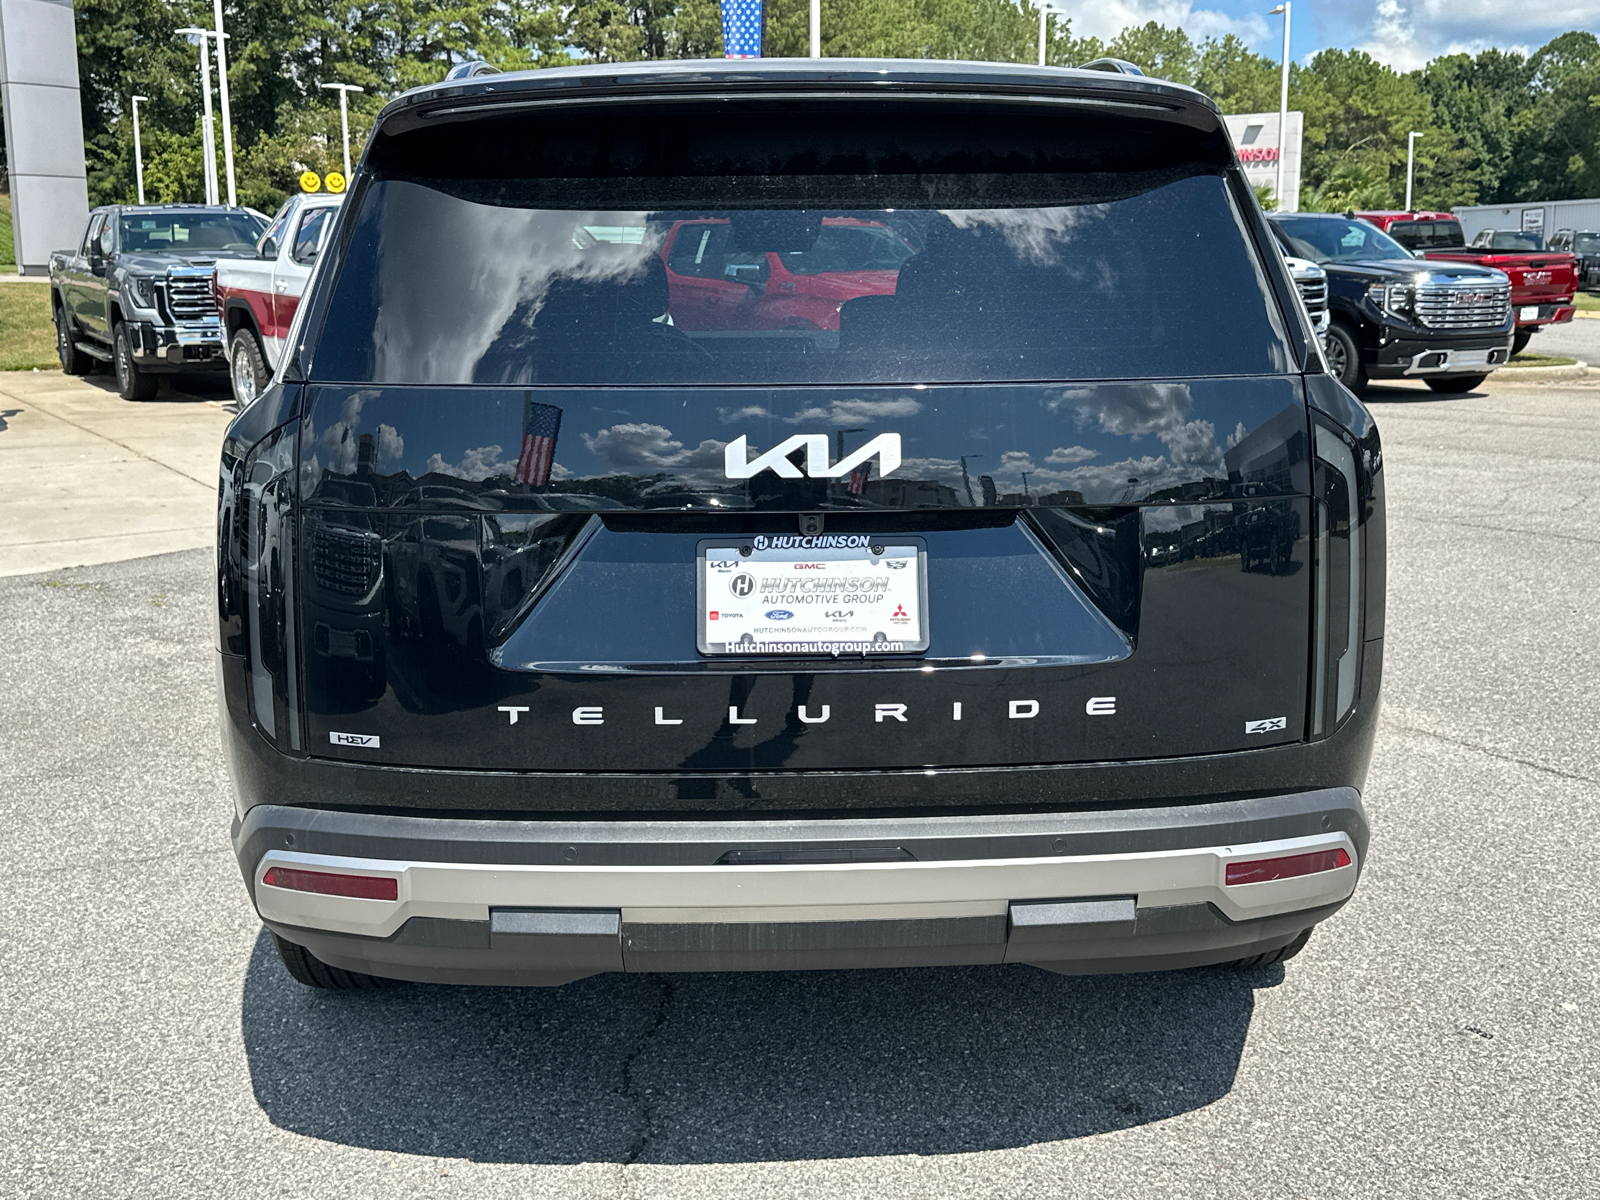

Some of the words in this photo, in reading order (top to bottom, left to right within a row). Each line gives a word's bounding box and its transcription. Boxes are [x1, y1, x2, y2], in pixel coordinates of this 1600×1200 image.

[1236, 147, 1286, 162] INSO
[725, 433, 901, 479] KIA
[771, 535, 871, 549] HUTCHINSON
[759, 577, 890, 594] HUTCHINSON
[762, 595, 839, 605] AUTOMOTIVE
[843, 594, 884, 604] GROUP
[770, 611, 789, 619] Ford
[825, 610, 854, 618] KIA
[725, 641, 904, 655] Hutchinsonautogroup.com
[497, 697, 1116, 725] TELLURIDE
[337, 734, 373, 745] HEV
